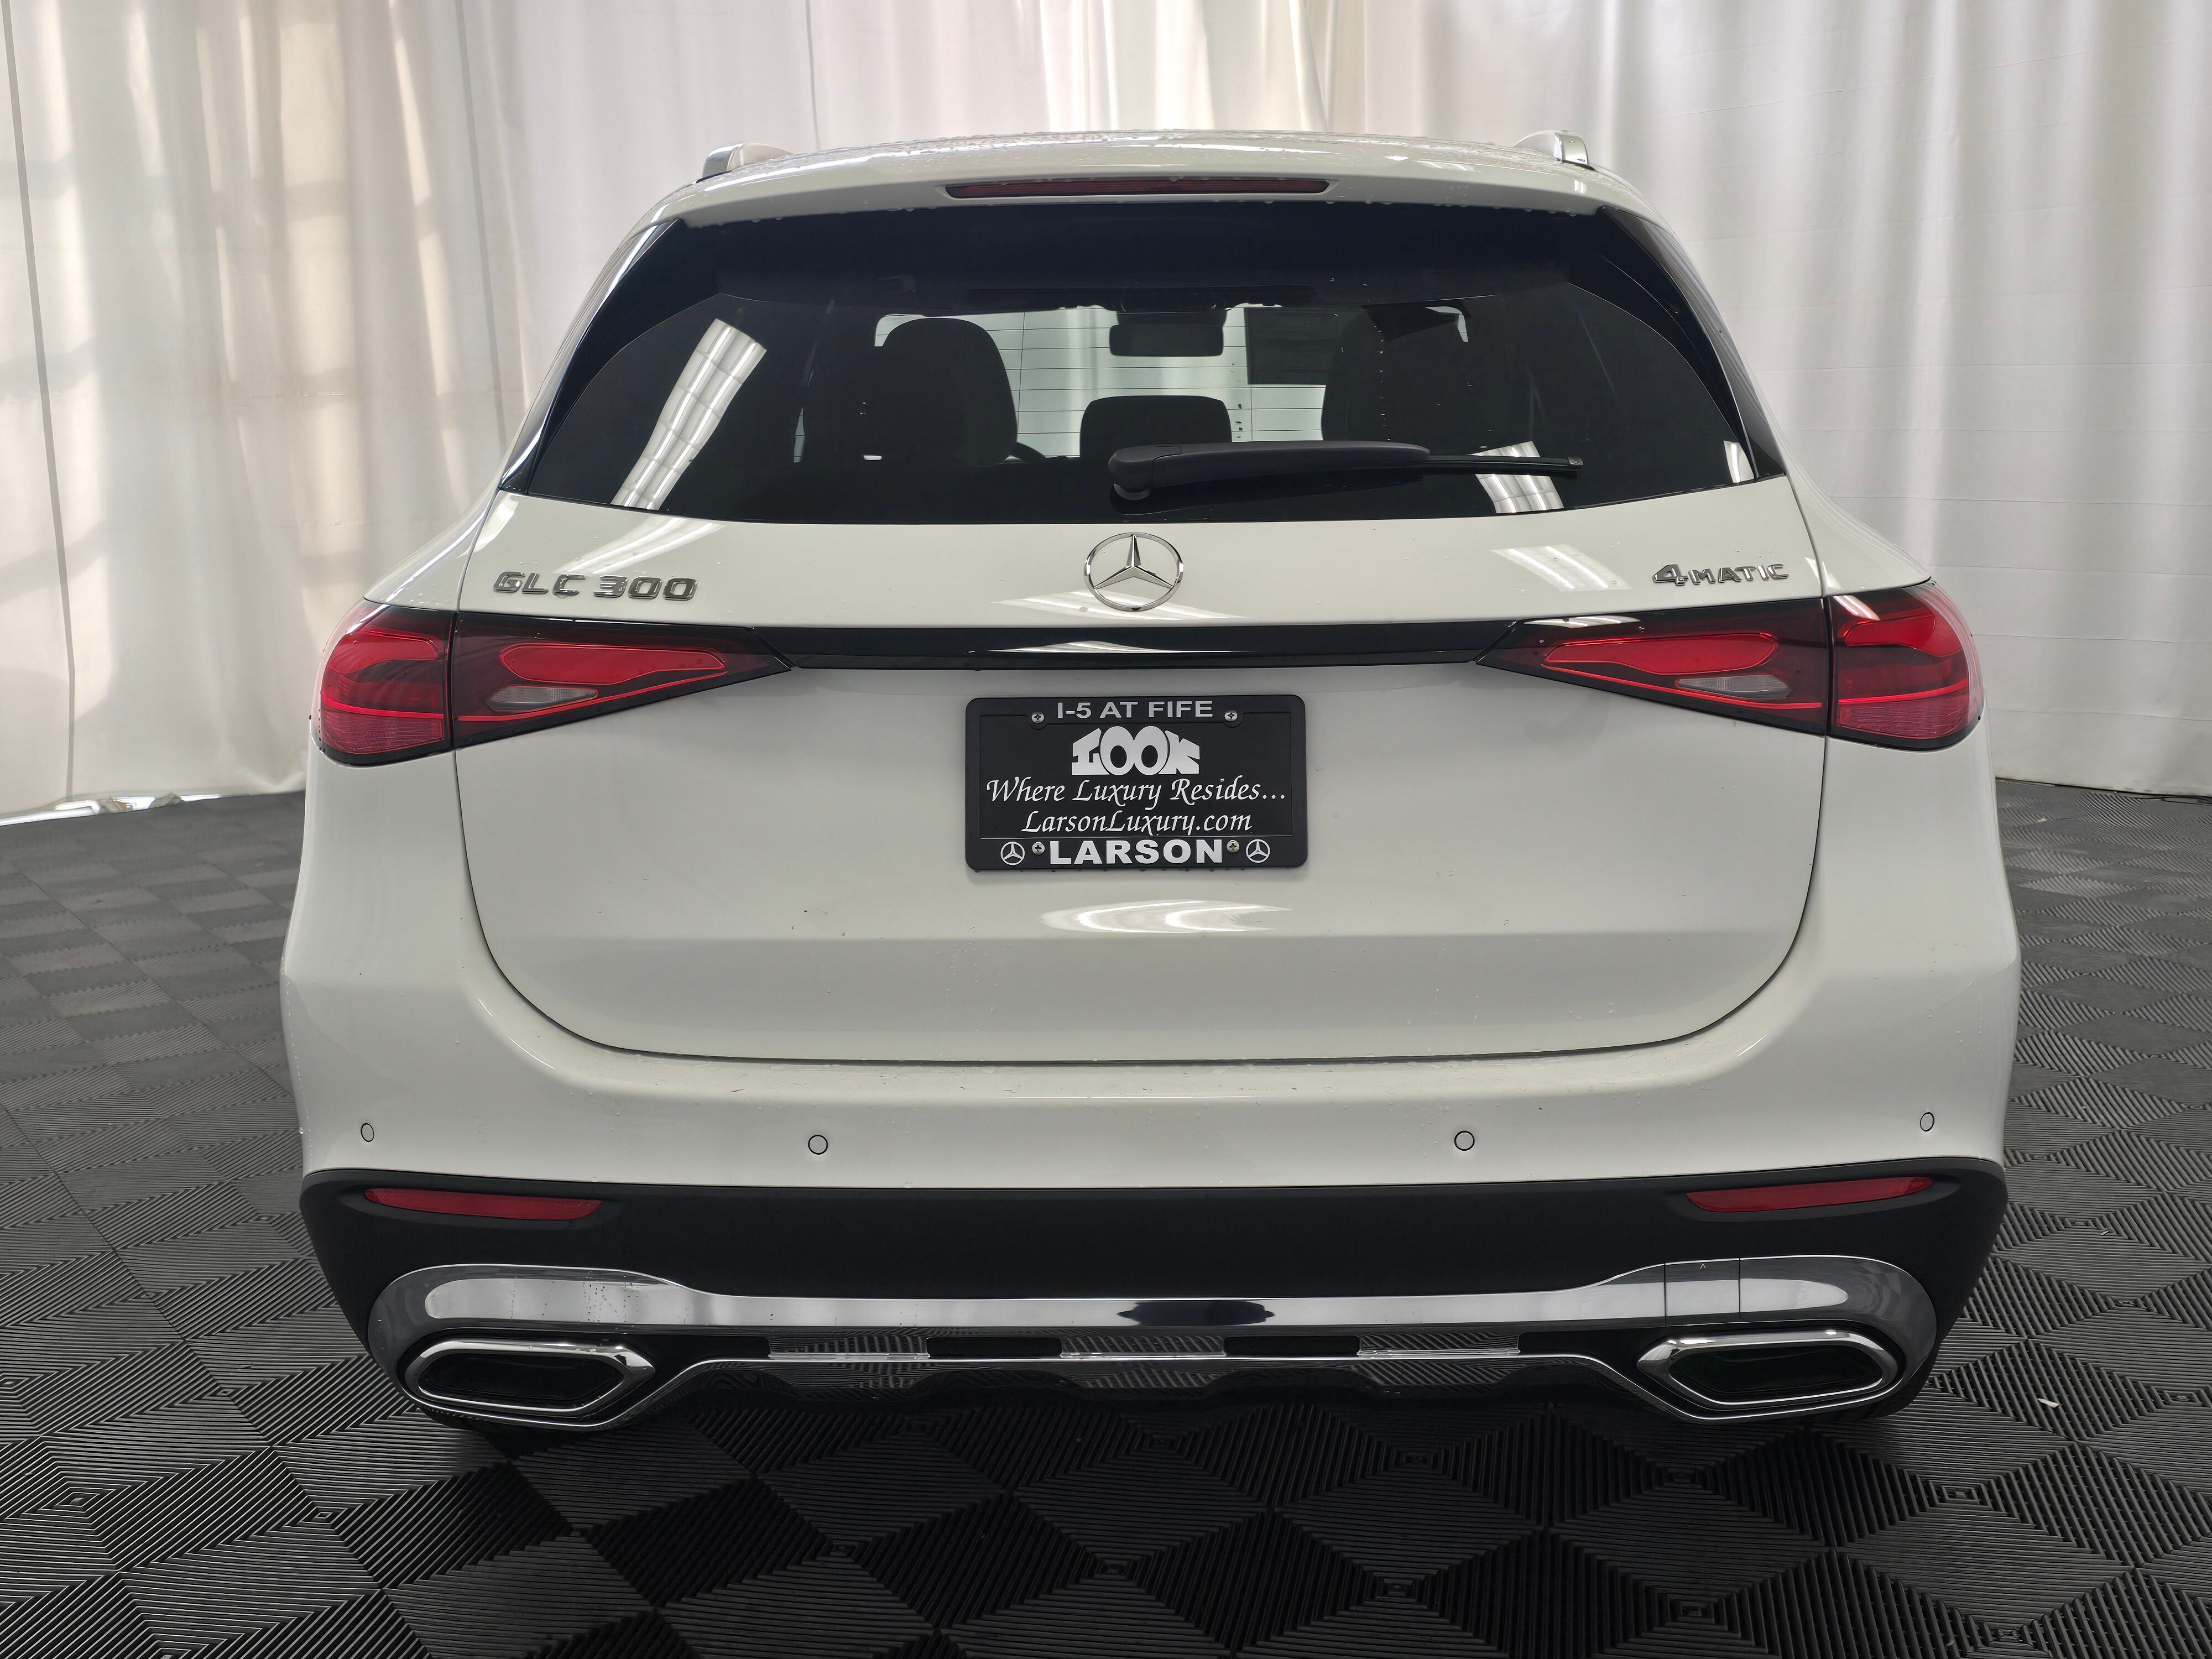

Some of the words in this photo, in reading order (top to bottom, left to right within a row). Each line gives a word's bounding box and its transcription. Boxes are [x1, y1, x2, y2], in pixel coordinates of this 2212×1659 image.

[493, 571, 586, 596] GLC
[593, 576, 697, 601] 300
[1652, 563, 1789, 586] 4MATIC
[1057, 702, 1091, 719] I-5
[1099, 701, 1138, 718] AT
[1149, 701, 1213, 717] FIFE
[987, 776, 1065, 802] Where
[1072, 779, 1162, 810] Luxury
[1171, 775, 1286, 804] Resides...
[1021, 810, 1253, 836] LarsonLuxury.com
[1050, 839, 1223, 864] LARSON
